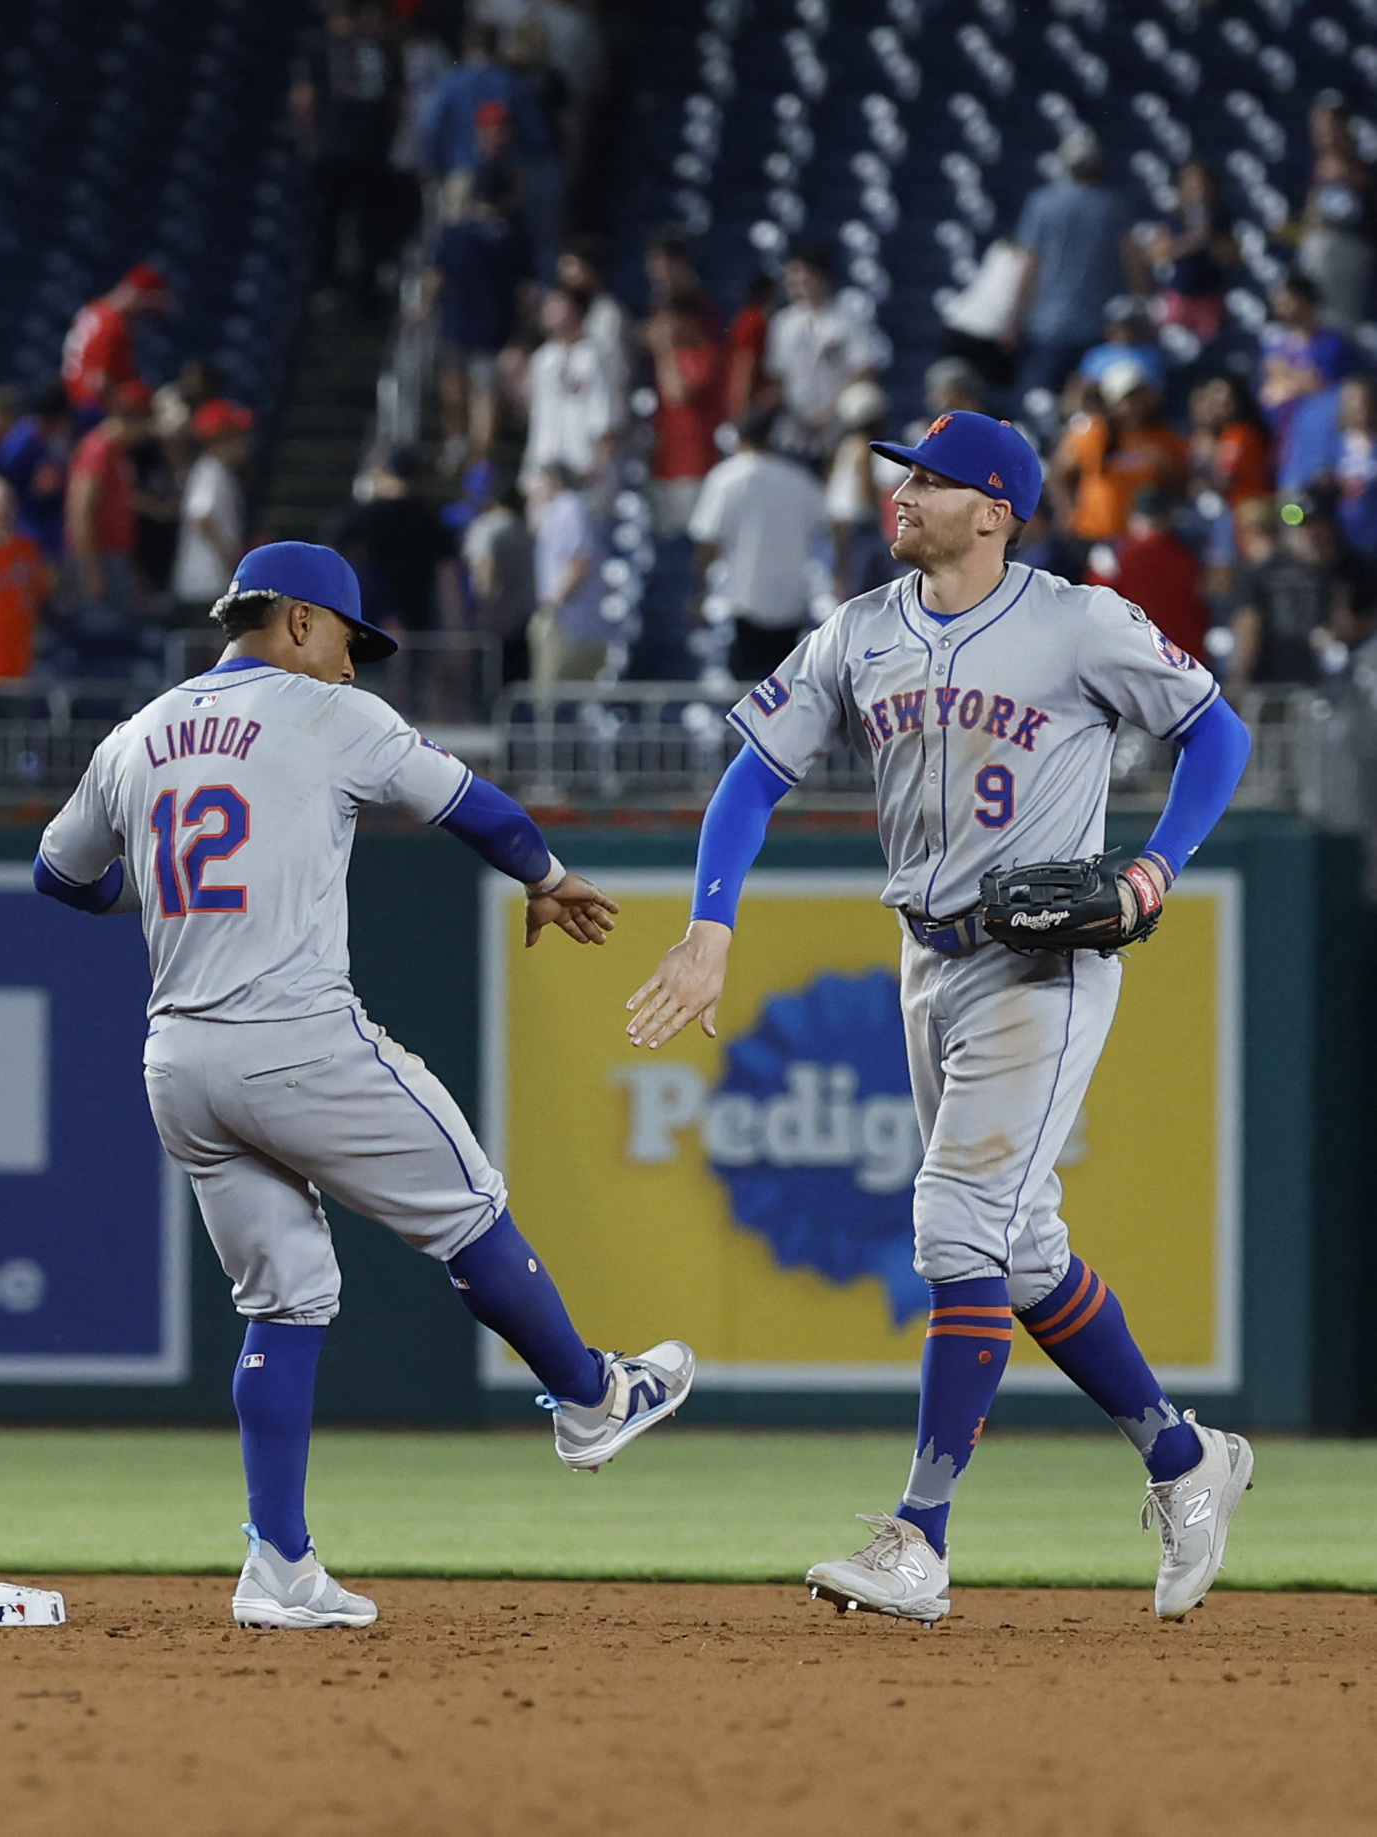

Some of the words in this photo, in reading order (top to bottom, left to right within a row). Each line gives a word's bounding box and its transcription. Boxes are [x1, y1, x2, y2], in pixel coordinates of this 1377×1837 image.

[144, 716, 262, 769] LINDOR
[935, 687, 1050, 752] YORK
[974, 764, 1015, 829] 9
[150, 784, 250, 918] 12
[1010, 909, 1071, 927] Rawlings
[612, 1060, 1088, 1194] Pedig
